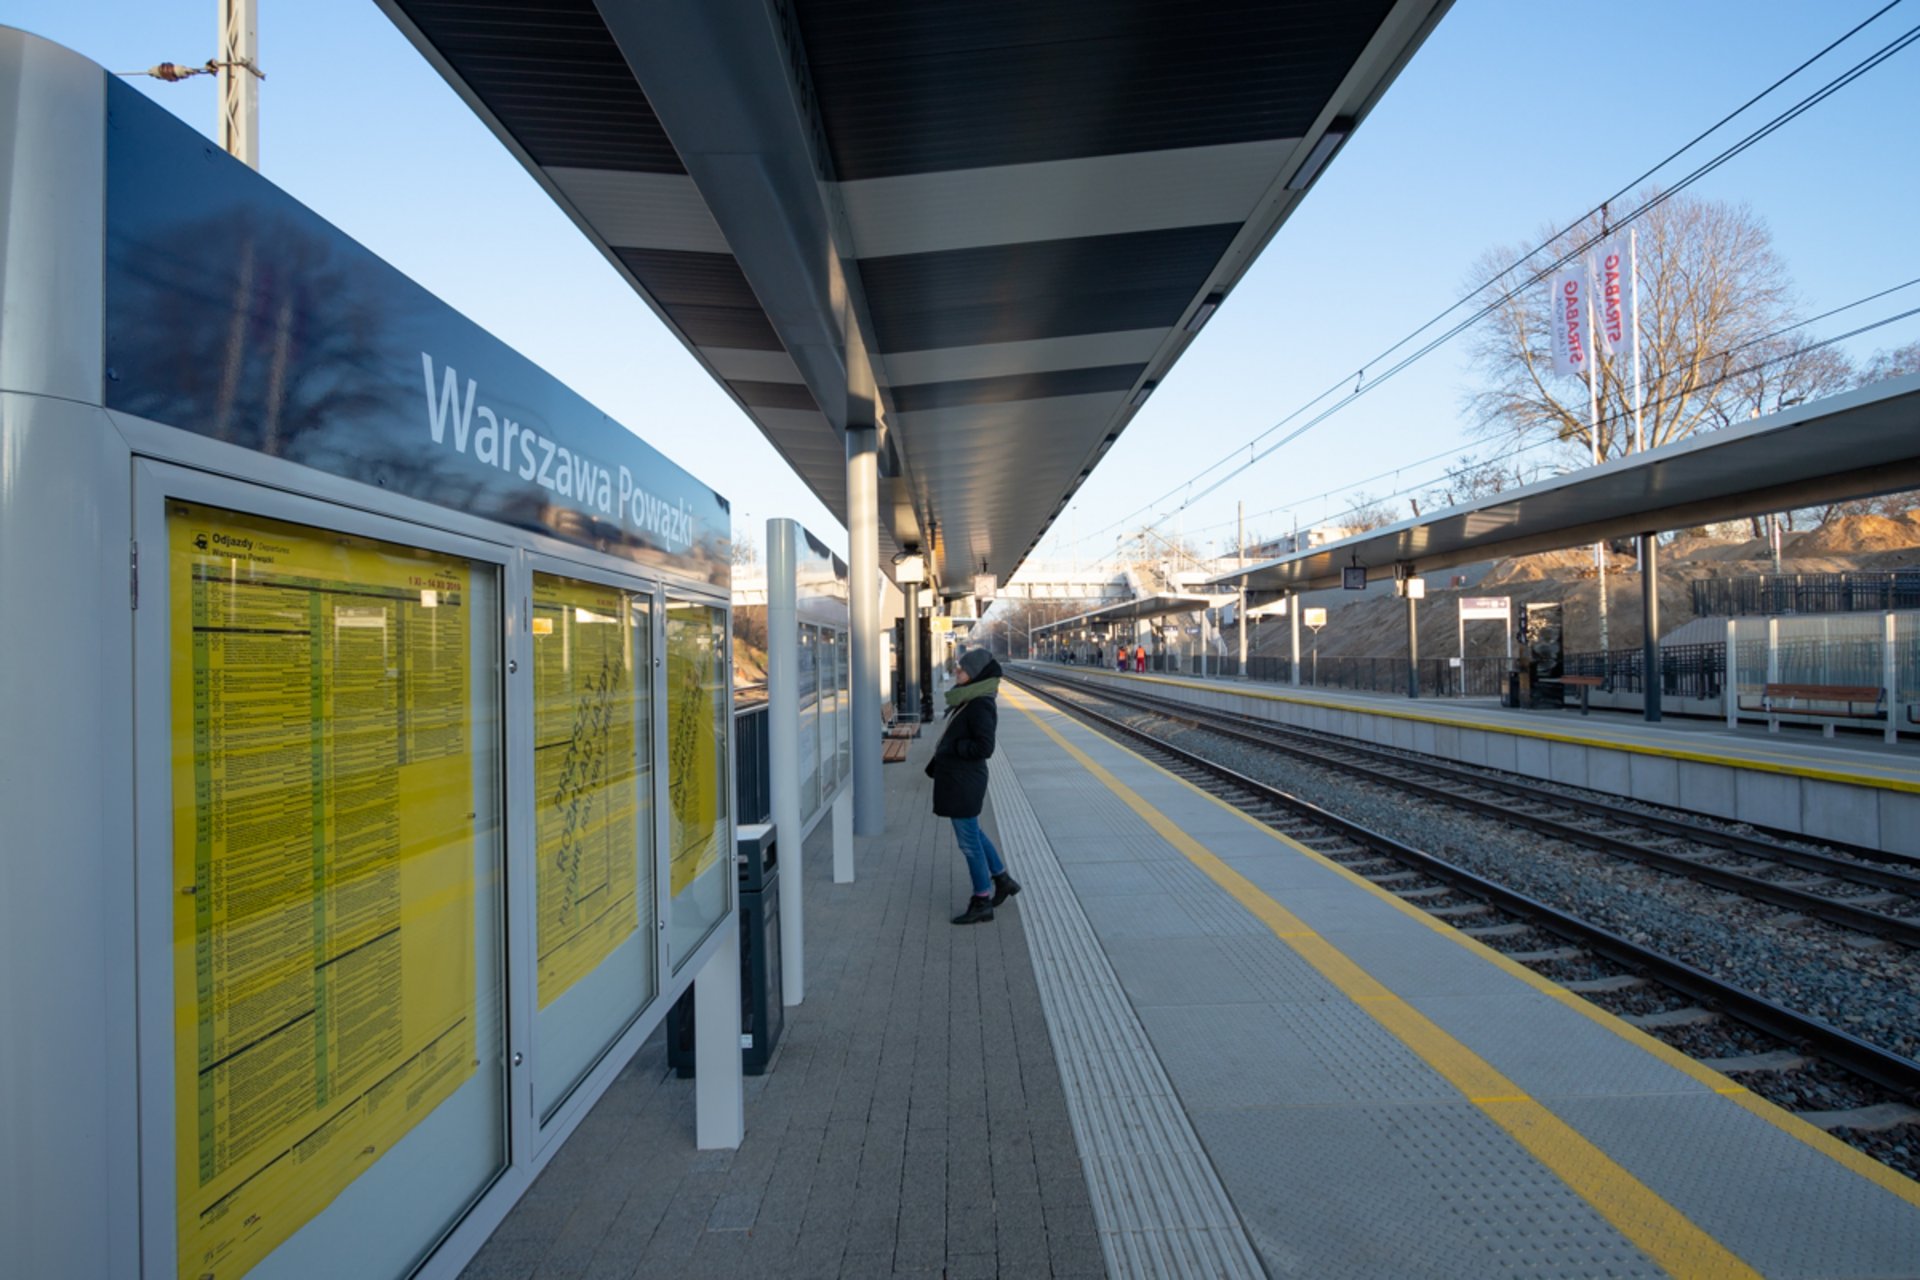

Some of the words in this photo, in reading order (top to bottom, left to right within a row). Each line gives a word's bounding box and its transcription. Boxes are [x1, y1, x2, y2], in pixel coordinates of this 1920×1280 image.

[421, 351, 612, 514] Warszawa
[618, 465, 693, 552] Powązki
[212, 533, 253, 550] Odjazdy
